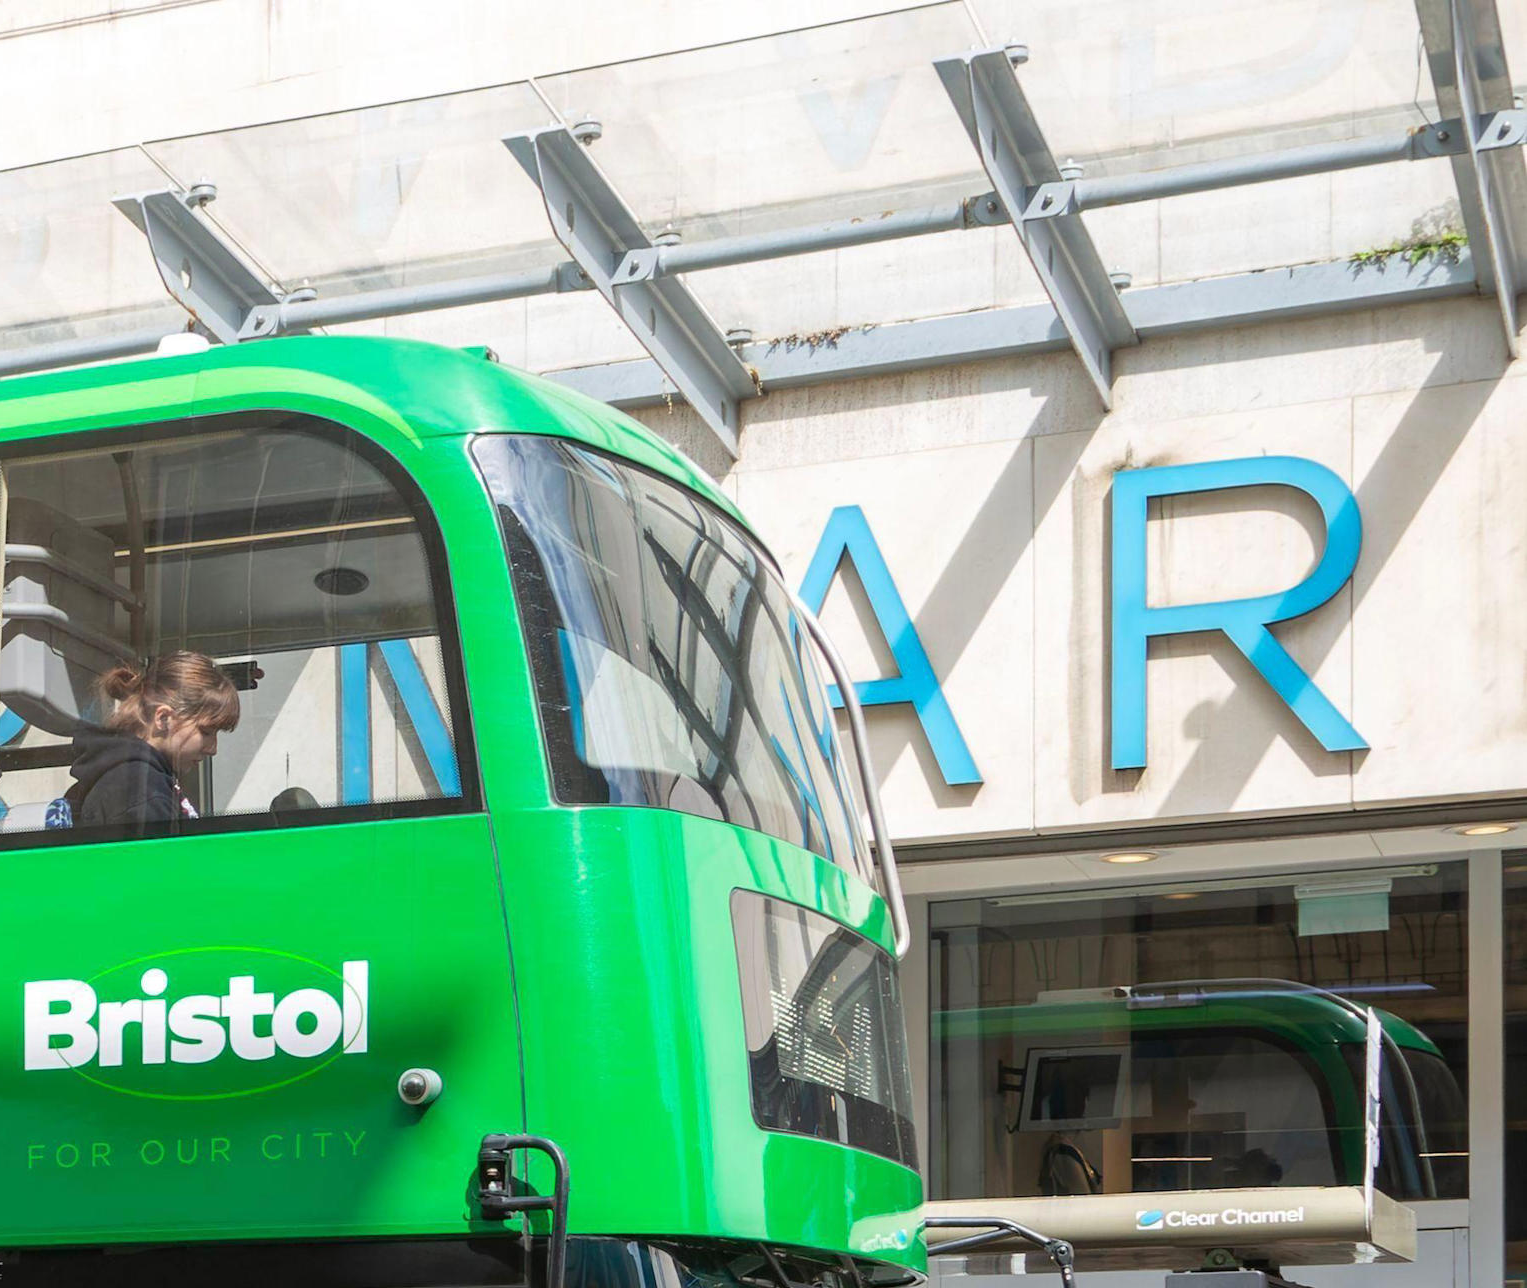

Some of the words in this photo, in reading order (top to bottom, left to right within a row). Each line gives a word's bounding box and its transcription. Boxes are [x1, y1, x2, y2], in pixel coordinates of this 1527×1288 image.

[24, 960, 369, 1070] Bristol
[28, 1142, 112, 1169] FOR
[140, 1137, 233, 1166] OUR
[262, 1130, 367, 1160] CITY
[1165, 1210, 1219, 1227] Clear
[1221, 1206, 1305, 1225] Channel
